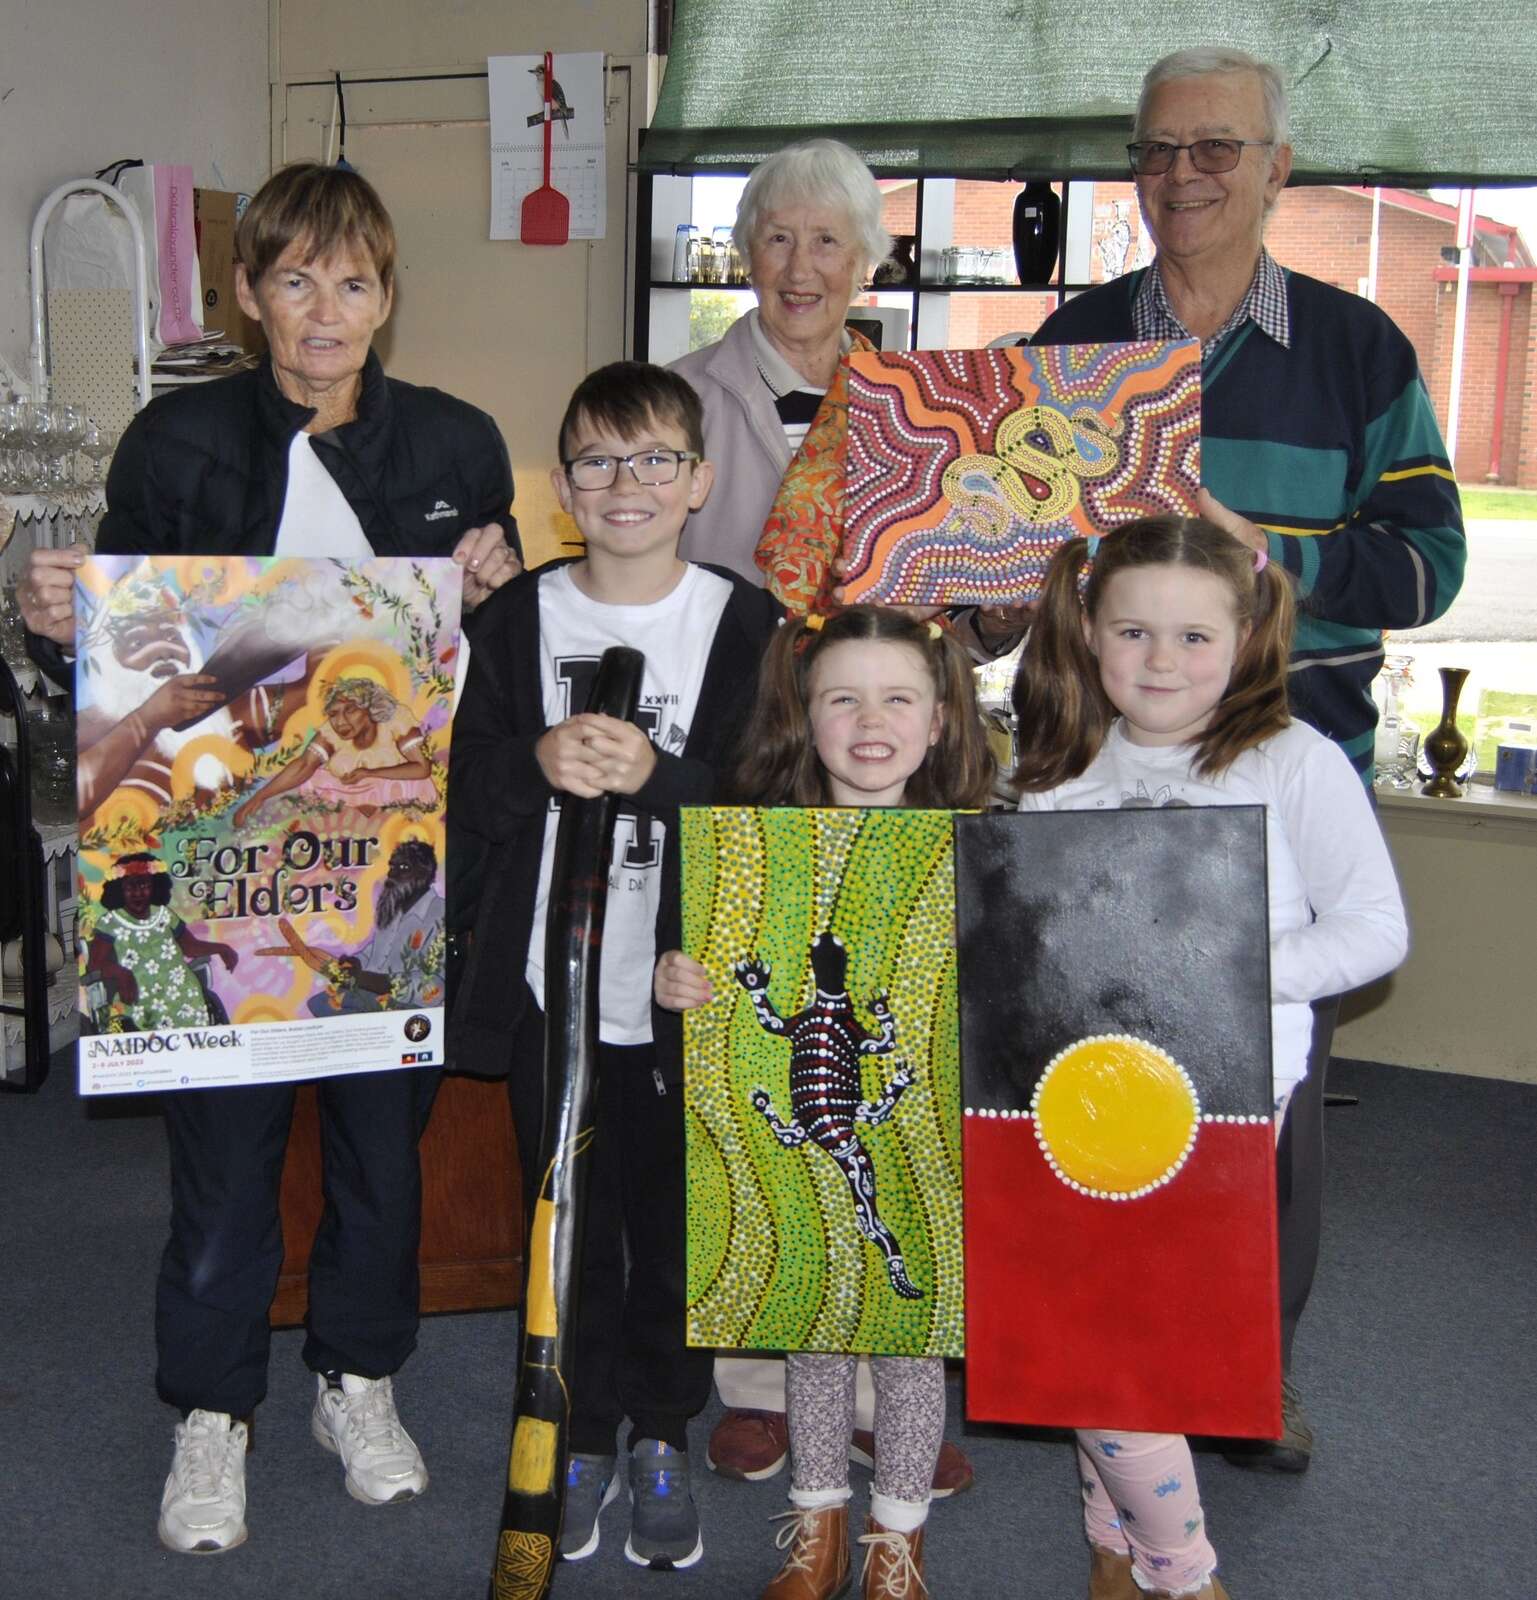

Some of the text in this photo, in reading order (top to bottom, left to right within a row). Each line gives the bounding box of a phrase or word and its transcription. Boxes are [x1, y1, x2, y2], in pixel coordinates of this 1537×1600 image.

[644, 694, 679, 705] XXVII
[171, 830, 379, 878] For Our
[189, 867, 357, 919] Elders
[88, 1033, 180, 1058] NAIDOC
[183, 1030, 243, 1049] Week
